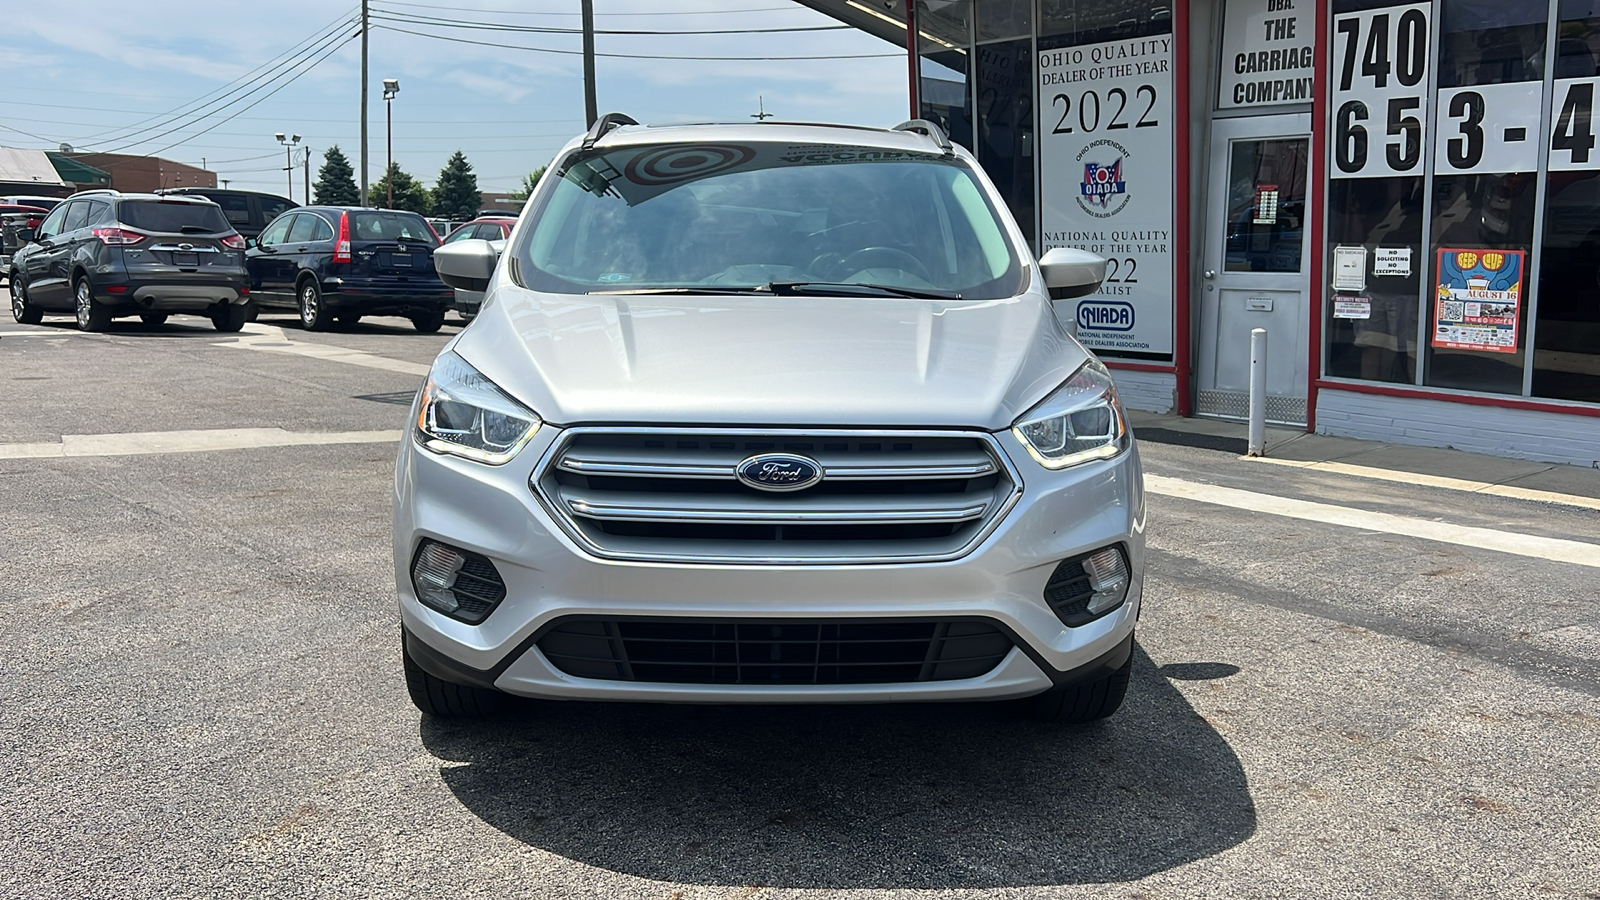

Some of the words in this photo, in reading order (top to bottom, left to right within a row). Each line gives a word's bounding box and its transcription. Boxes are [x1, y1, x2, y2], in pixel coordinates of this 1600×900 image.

[1264, 17, 1297, 41] THE
[1040, 50, 1083, 68] OHIO
[1091, 38, 1171, 63] QUALITY
[1337, 8, 1427, 91] 740
[1234, 46, 1315, 75] CARRIAG
[1042, 69, 1087, 85] DEALER
[1089, 67, 1105, 80] OF
[1107, 63, 1132, 78] THE
[1135, 59, 1169, 75] YEAR
[1052, 84, 1158, 135] 2022
[1075, 145, 1090, 162] OHIO
[1089, 139, 1131, 159] INDEPENDENT
[1085, 182, 1118, 194] OIADA
[1044, 231, 1106, 241] NATIONAL
[1111, 231, 1169, 242] QUALITY
[1091, 244, 1105, 253] OF
[1110, 244, 1132, 253] THE
[1137, 243, 1167, 253] YEAR
[1106, 258, 1138, 283] 22
[1457, 252, 1478, 269] BEER
[1096, 286, 1132, 295] ALIST
[1467, 290, 1504, 299] AUGUST
[1081, 307, 1129, 327] NIADA
[1116, 341, 1150, 349] ASSOCIATION
[758, 462, 801, 480] Ford
